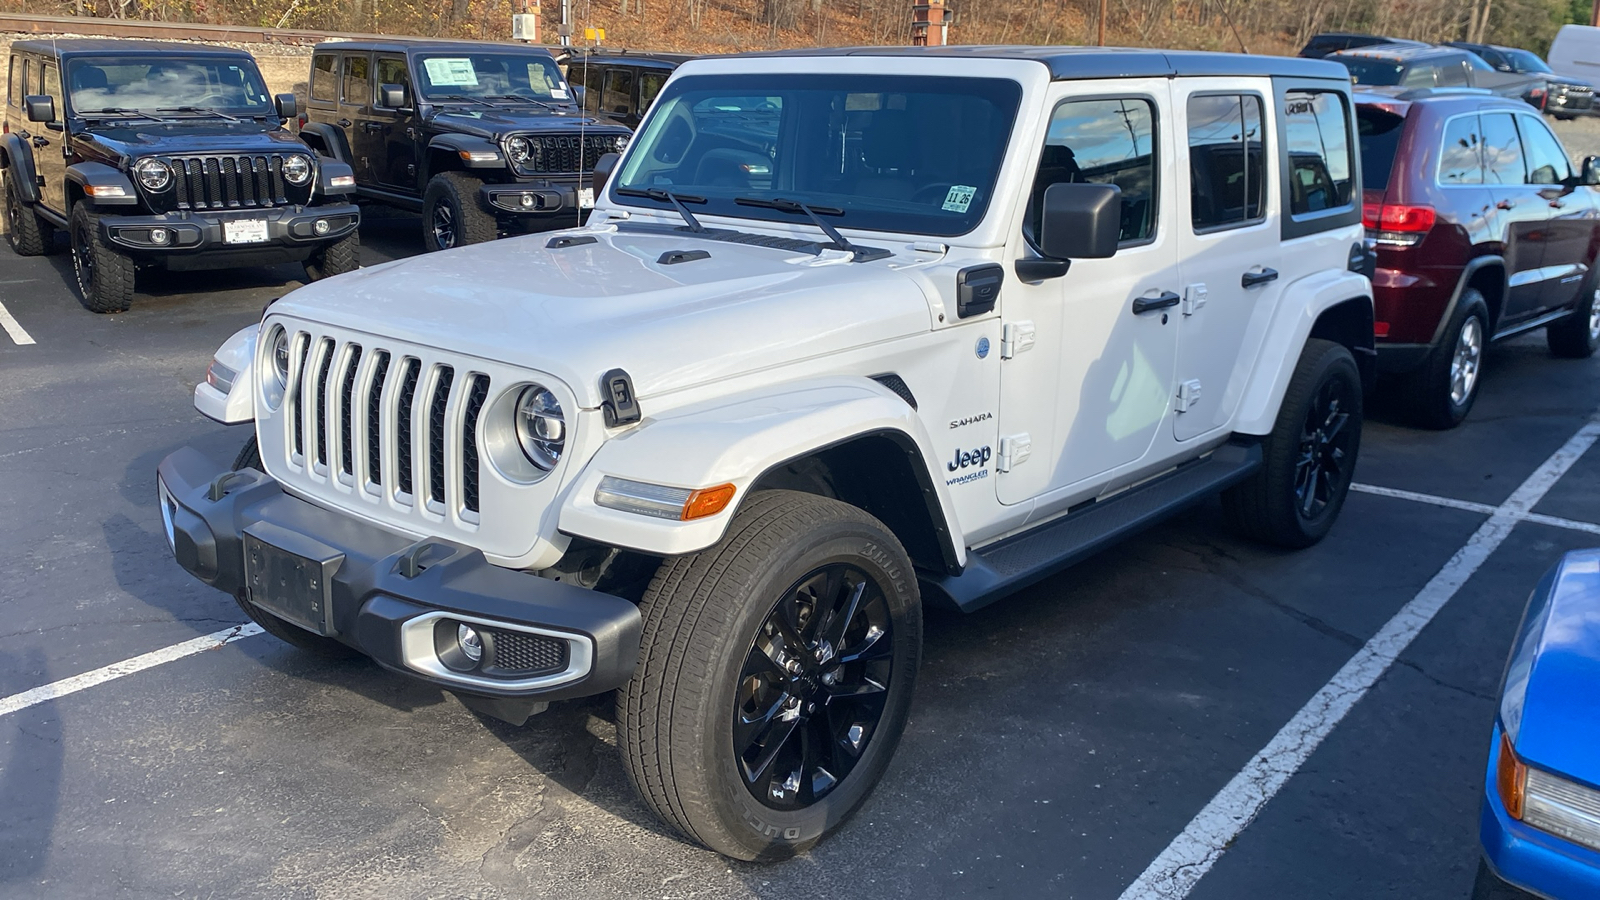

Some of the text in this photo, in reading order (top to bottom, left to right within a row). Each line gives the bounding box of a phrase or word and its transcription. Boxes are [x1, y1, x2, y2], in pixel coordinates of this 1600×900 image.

[948, 192, 970, 204] 11 26
[949, 412, 993, 429] SAHARA
[947, 445, 991, 471] Jeep
[946, 469, 988, 486] WRANGLER
